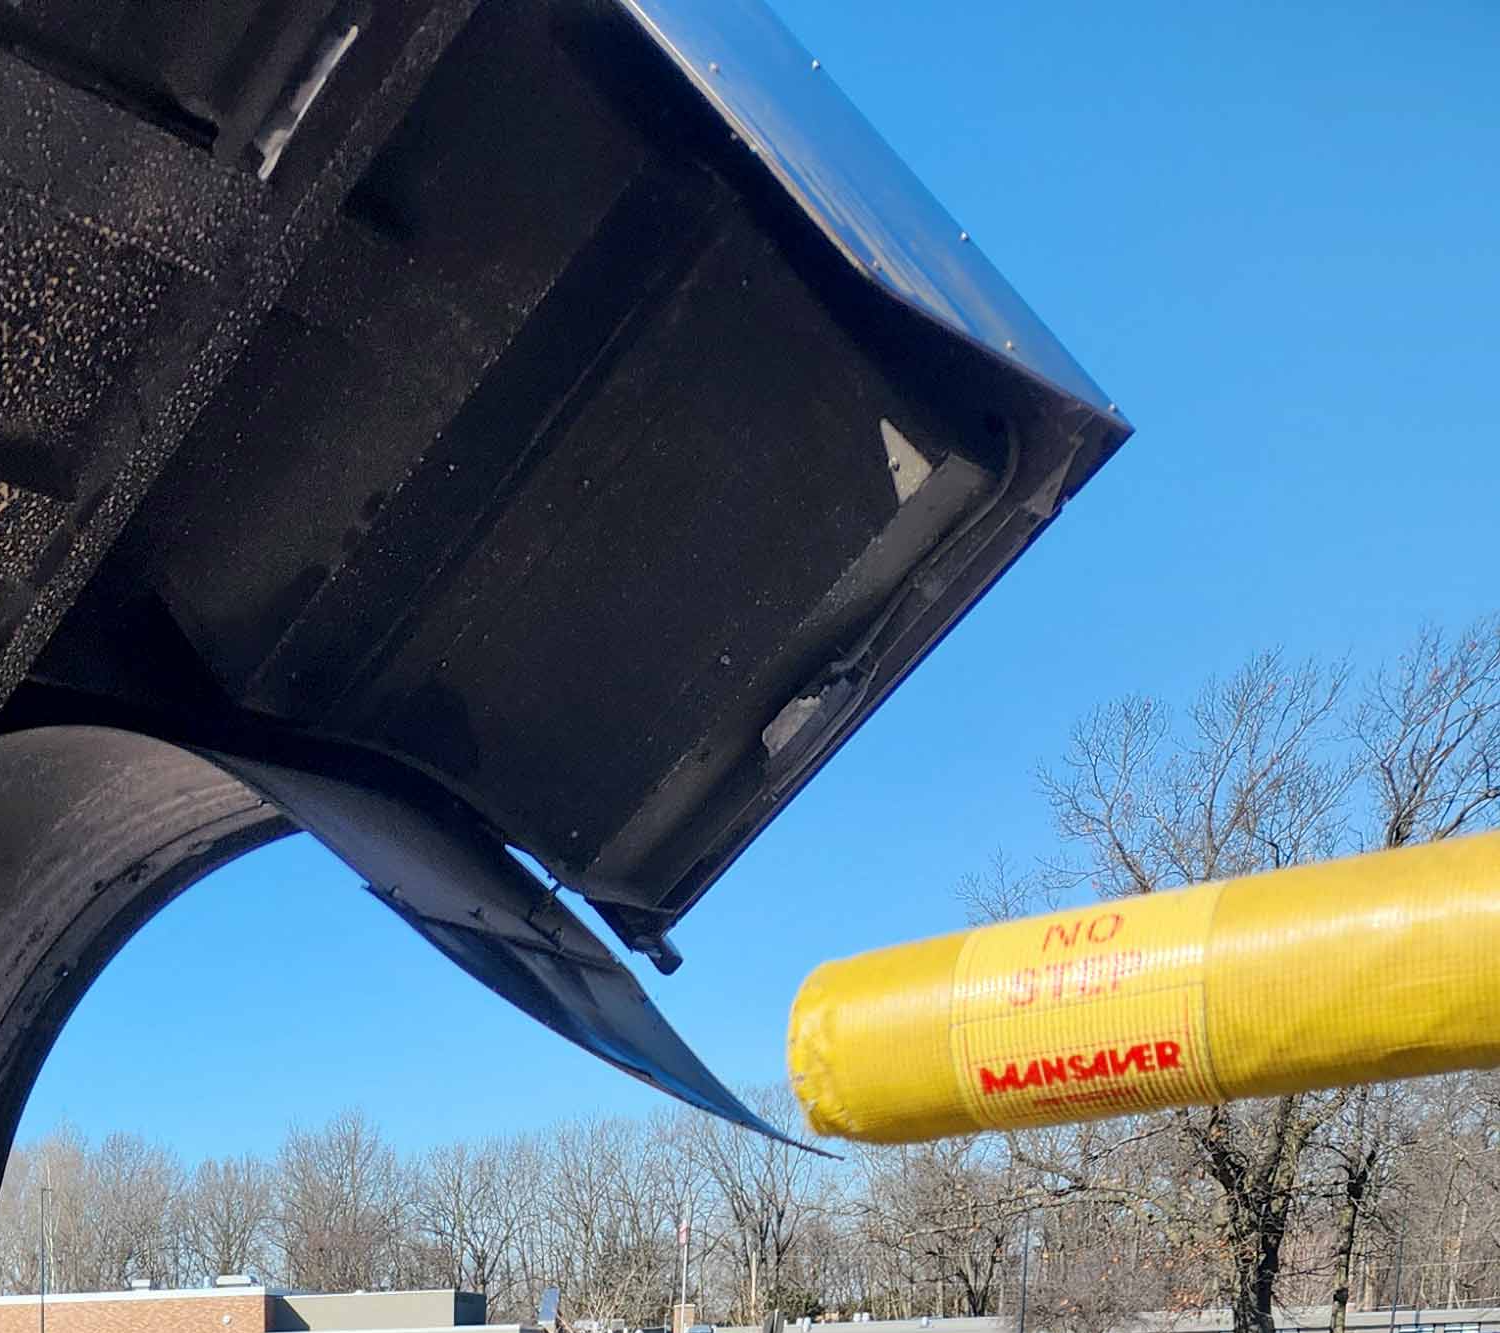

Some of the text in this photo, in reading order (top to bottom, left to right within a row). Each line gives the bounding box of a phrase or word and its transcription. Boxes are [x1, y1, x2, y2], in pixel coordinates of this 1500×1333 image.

[1041, 913, 1125, 952] NO
[1009, 949, 1142, 1008] STEP
[979, 1040, 1183, 1096] MANSAVER
